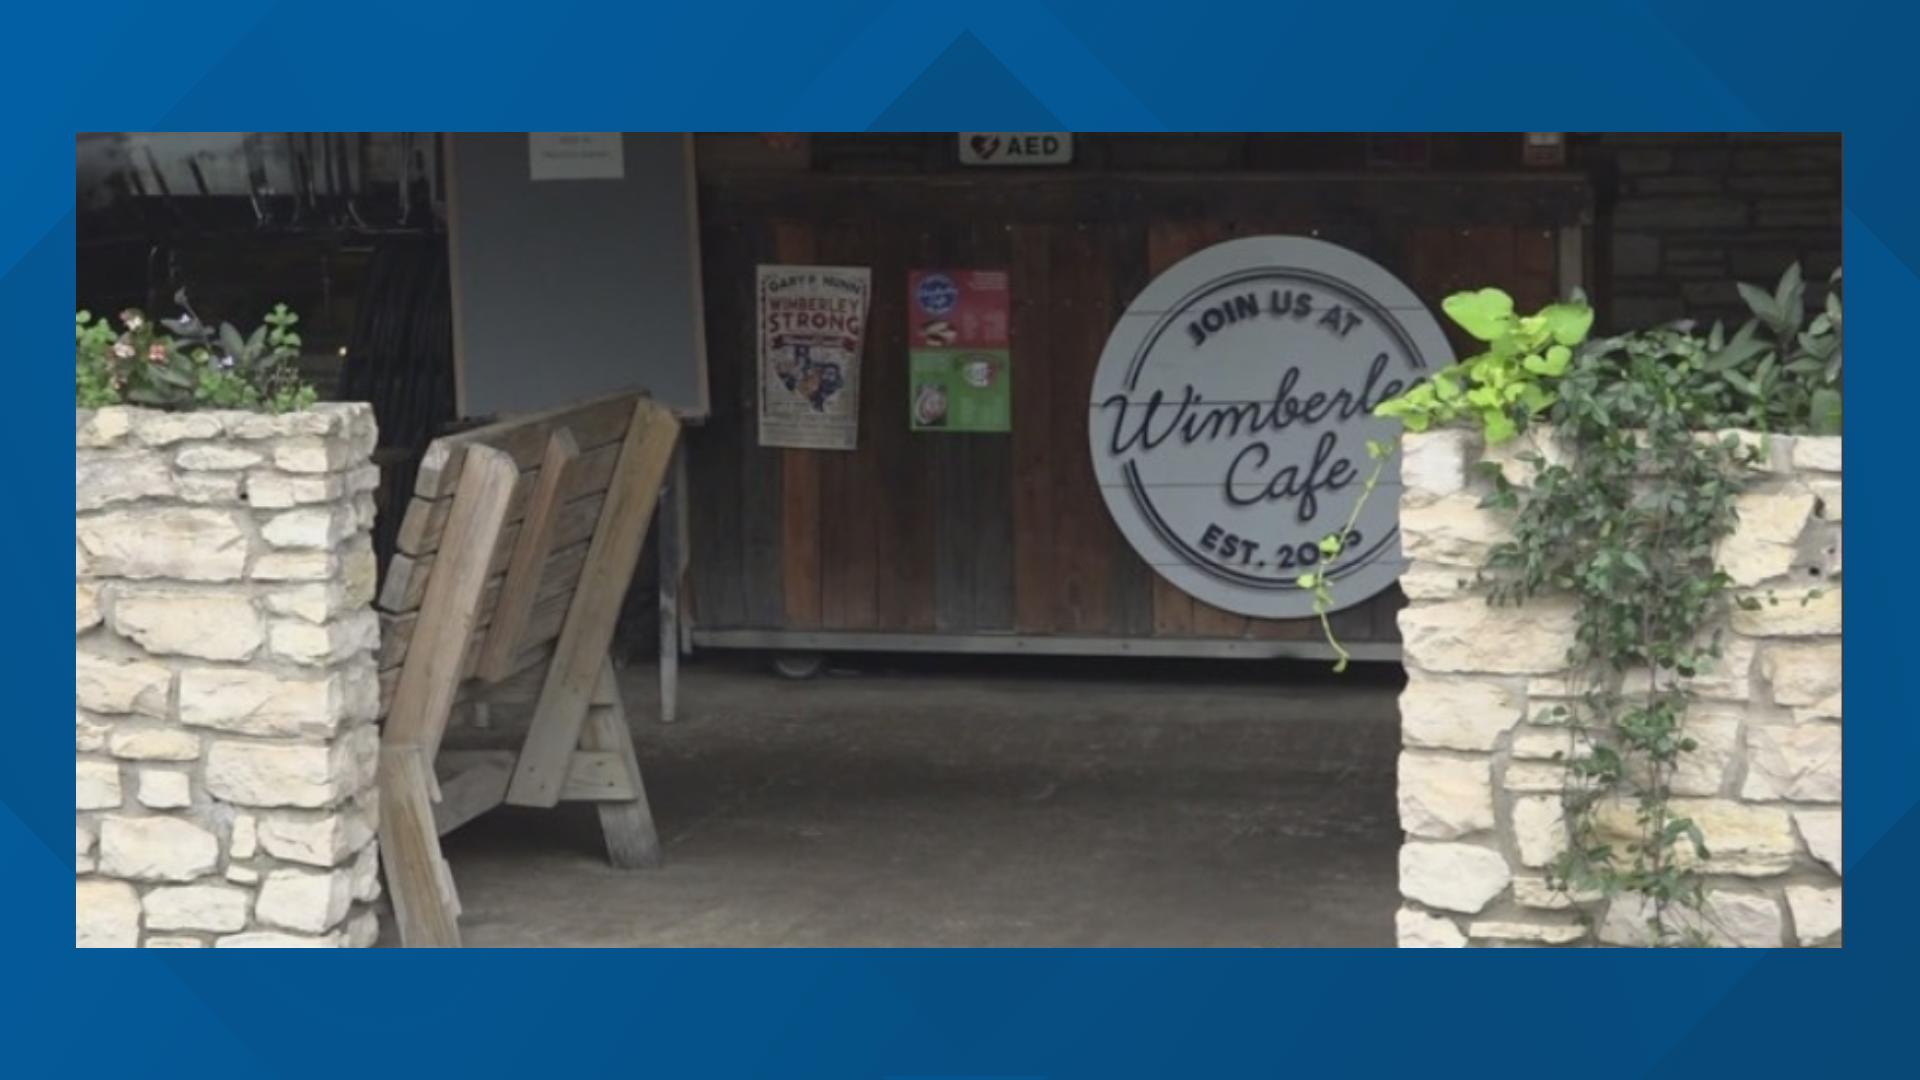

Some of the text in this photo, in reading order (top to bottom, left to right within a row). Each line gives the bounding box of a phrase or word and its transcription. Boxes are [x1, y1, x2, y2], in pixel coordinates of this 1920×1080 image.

[1006, 136, 1059, 156] AED
[769, 297, 859, 312] WIMBERLEY
[1187, 290, 1362, 346] JOIN US AT
[769, 311, 860, 336] STRONG
[1226, 431, 1358, 521] Cafe
[1200, 523, 1265, 567] EST.
